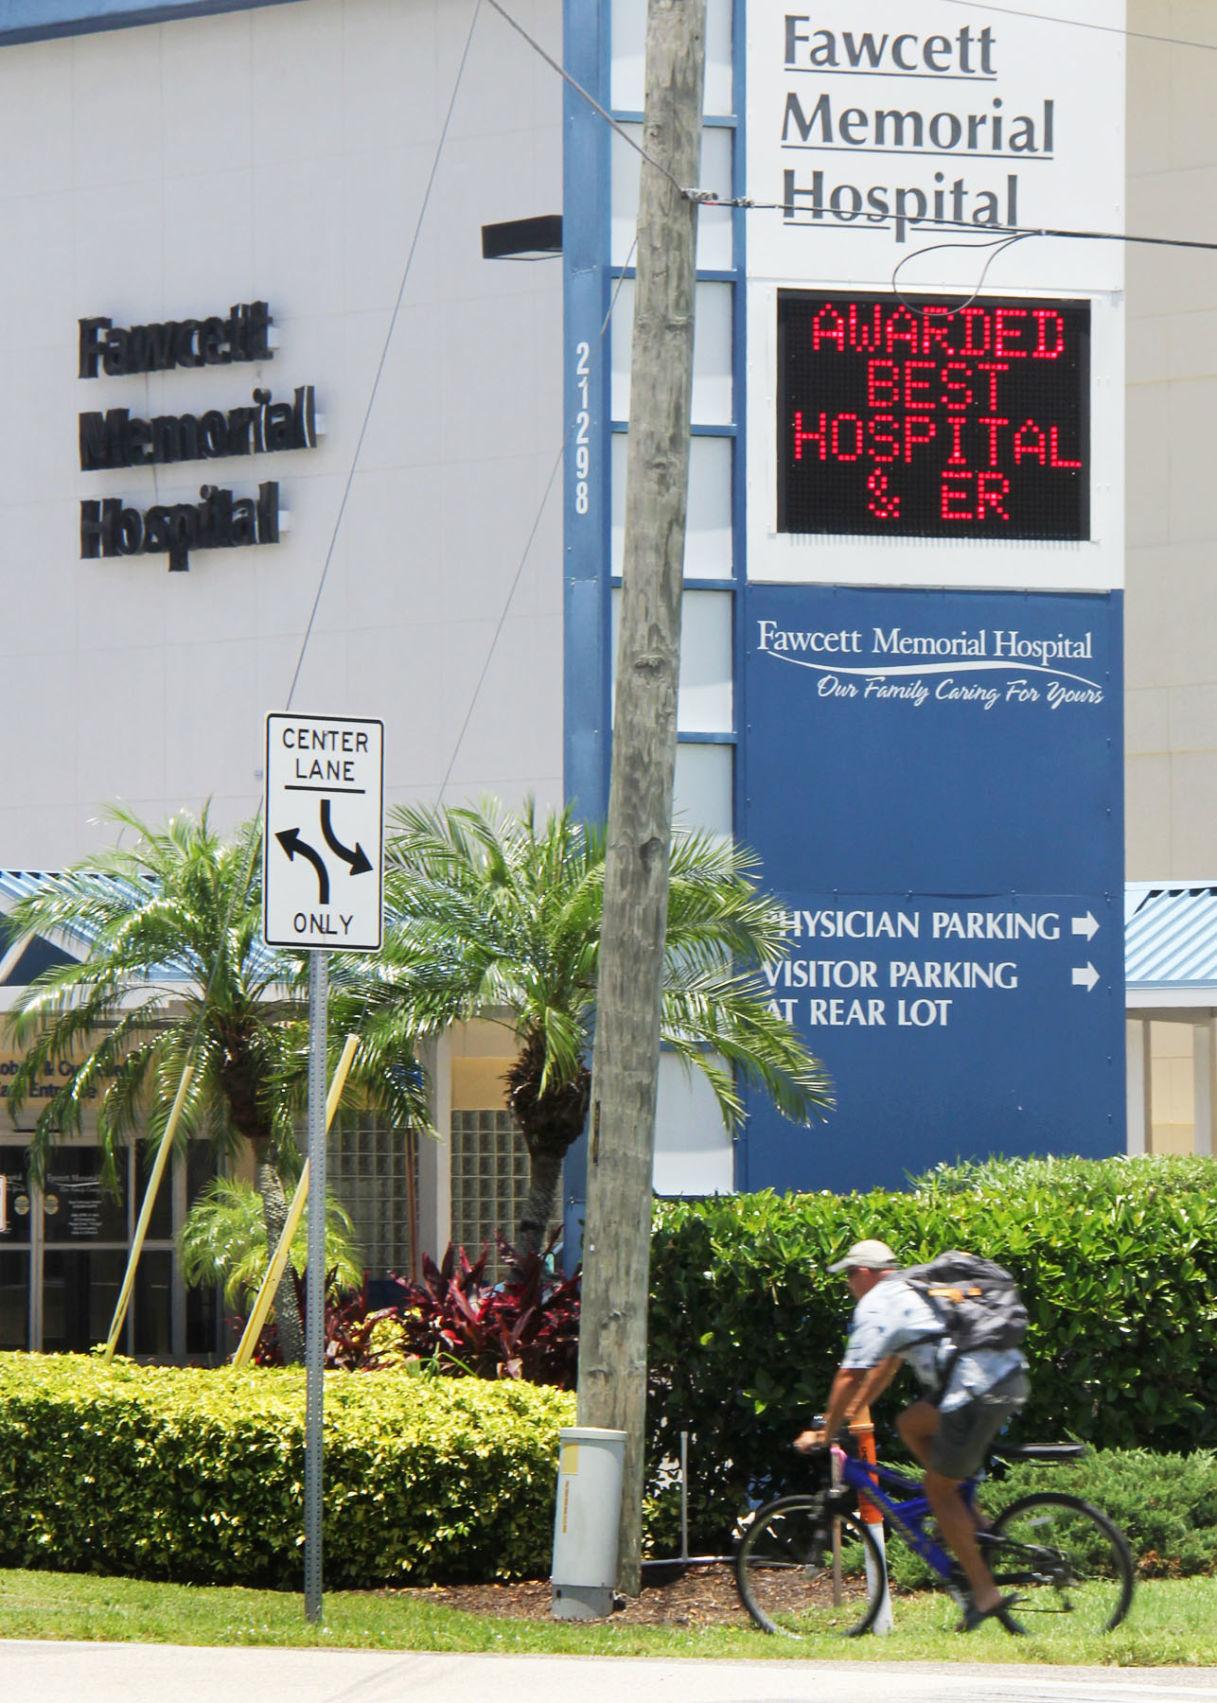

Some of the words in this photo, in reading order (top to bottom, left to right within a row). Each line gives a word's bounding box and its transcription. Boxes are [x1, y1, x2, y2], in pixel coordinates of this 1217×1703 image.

[783, 14, 998, 76] Fawcett
[780, 91, 1055, 153] Memorial
[783, 168, 1018, 243] Hospital
[78, 300, 274, 379] Fawcett
[812, 303, 1065, 358] AWARDED
[868, 359, 1010, 412] BEST
[78, 385, 317, 472] Memorial
[575, 341, 591, 515] 21298
[794, 411, 1083, 469] HOSPITAL
[868, 467, 901, 519] &
[941, 470, 1010, 521] ER
[80, 481, 280, 572] Hospital
[756, 620, 864, 654] Fawcett
[872, 627, 987, 657] Memorial
[993, 630, 1093, 667] Hospital
[817, 674, 858, 699] Our
[864, 676, 930, 707] Family
[935, 678, 1001, 710] Caring
[1004, 679, 1041, 702] For
[1047, 681, 1105, 710] Yours
[282, 727, 369, 753] CENTER
[296, 758, 356, 782] LANE
[293, 912, 354, 935] ONLY
[932, 911, 1061, 940] PARKING
[763, 960, 878, 989] VISITOR
[889, 961, 1019, 989] PARKING
[810, 999, 887, 1027] REAR
[898, 999, 953, 1027] LOT
